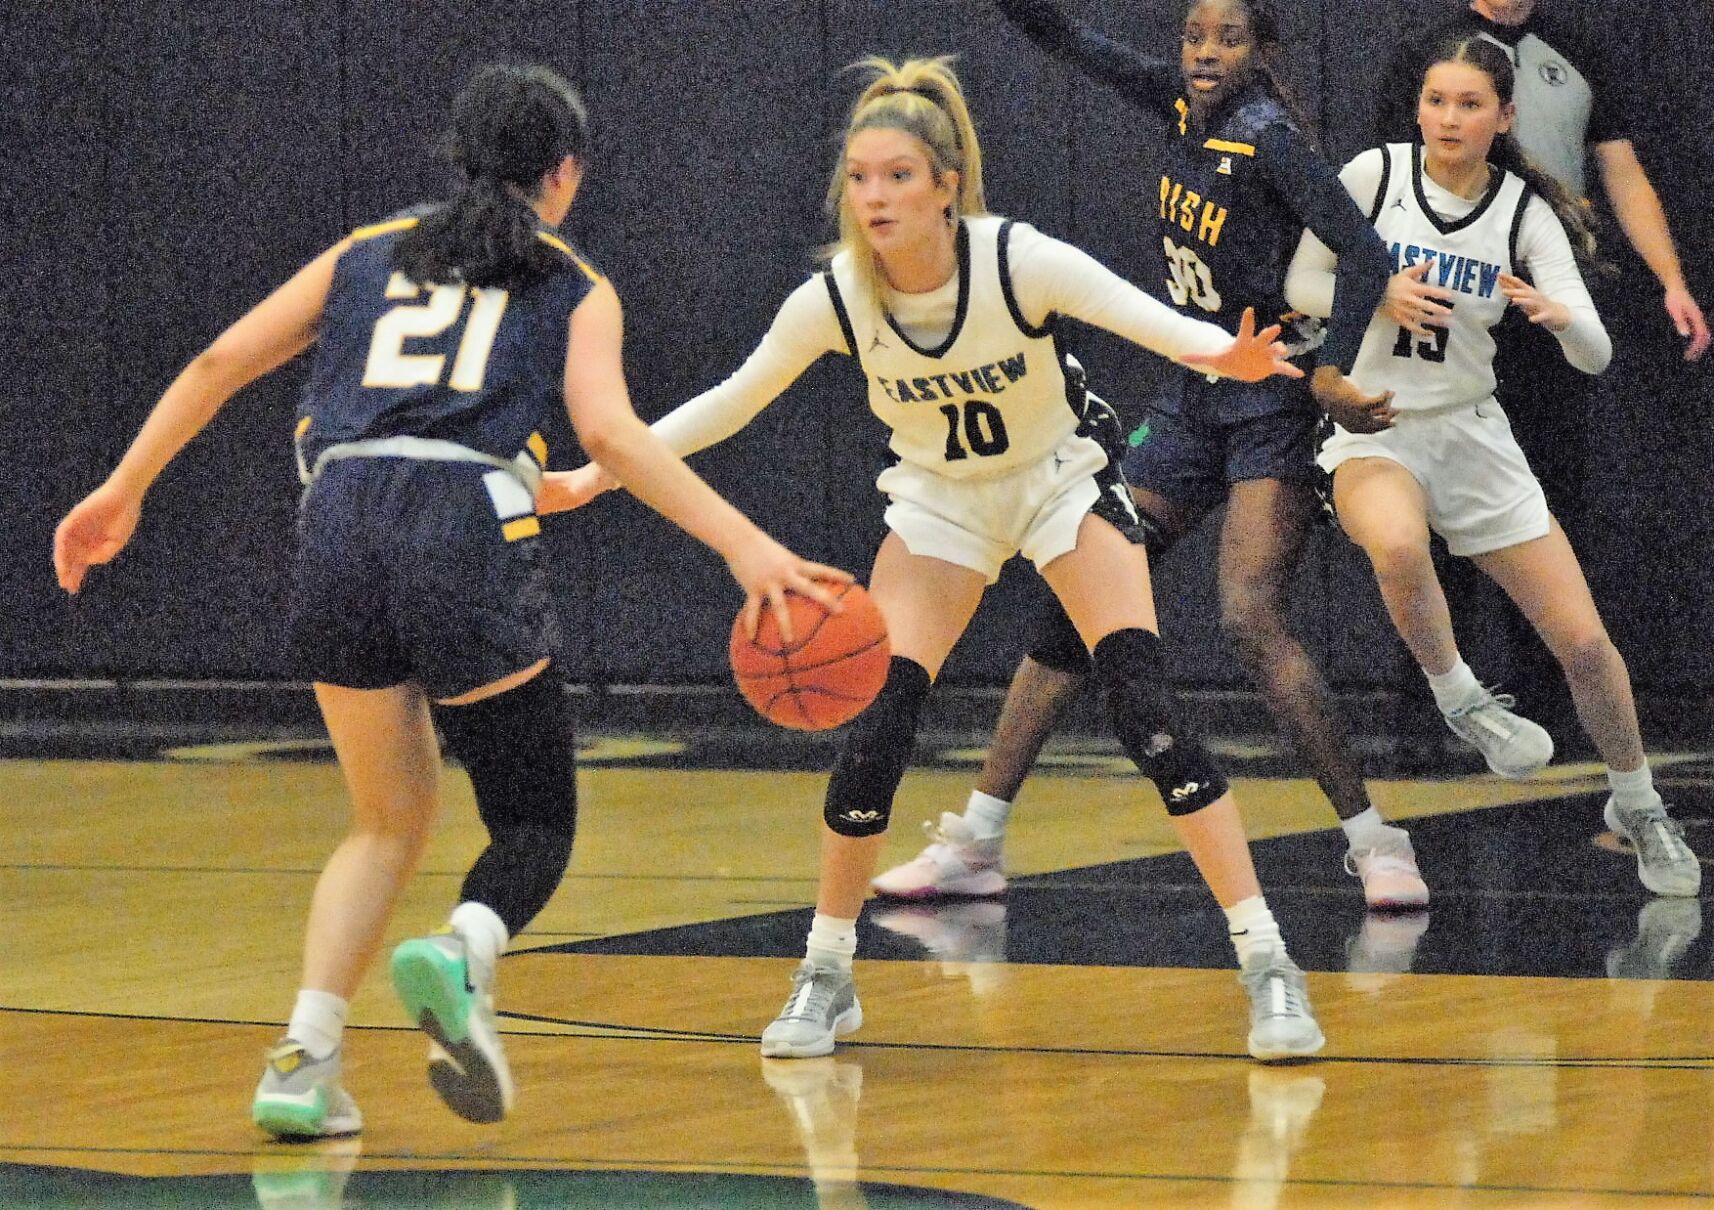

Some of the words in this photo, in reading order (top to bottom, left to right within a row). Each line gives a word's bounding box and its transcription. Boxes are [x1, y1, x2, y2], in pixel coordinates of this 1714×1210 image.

[1388, 242, 1501, 299] ASTVIEW
[361, 270, 509, 392] 21
[877, 352, 1028, 403] EASTVIEW
[939, 399, 1010, 462] 10
